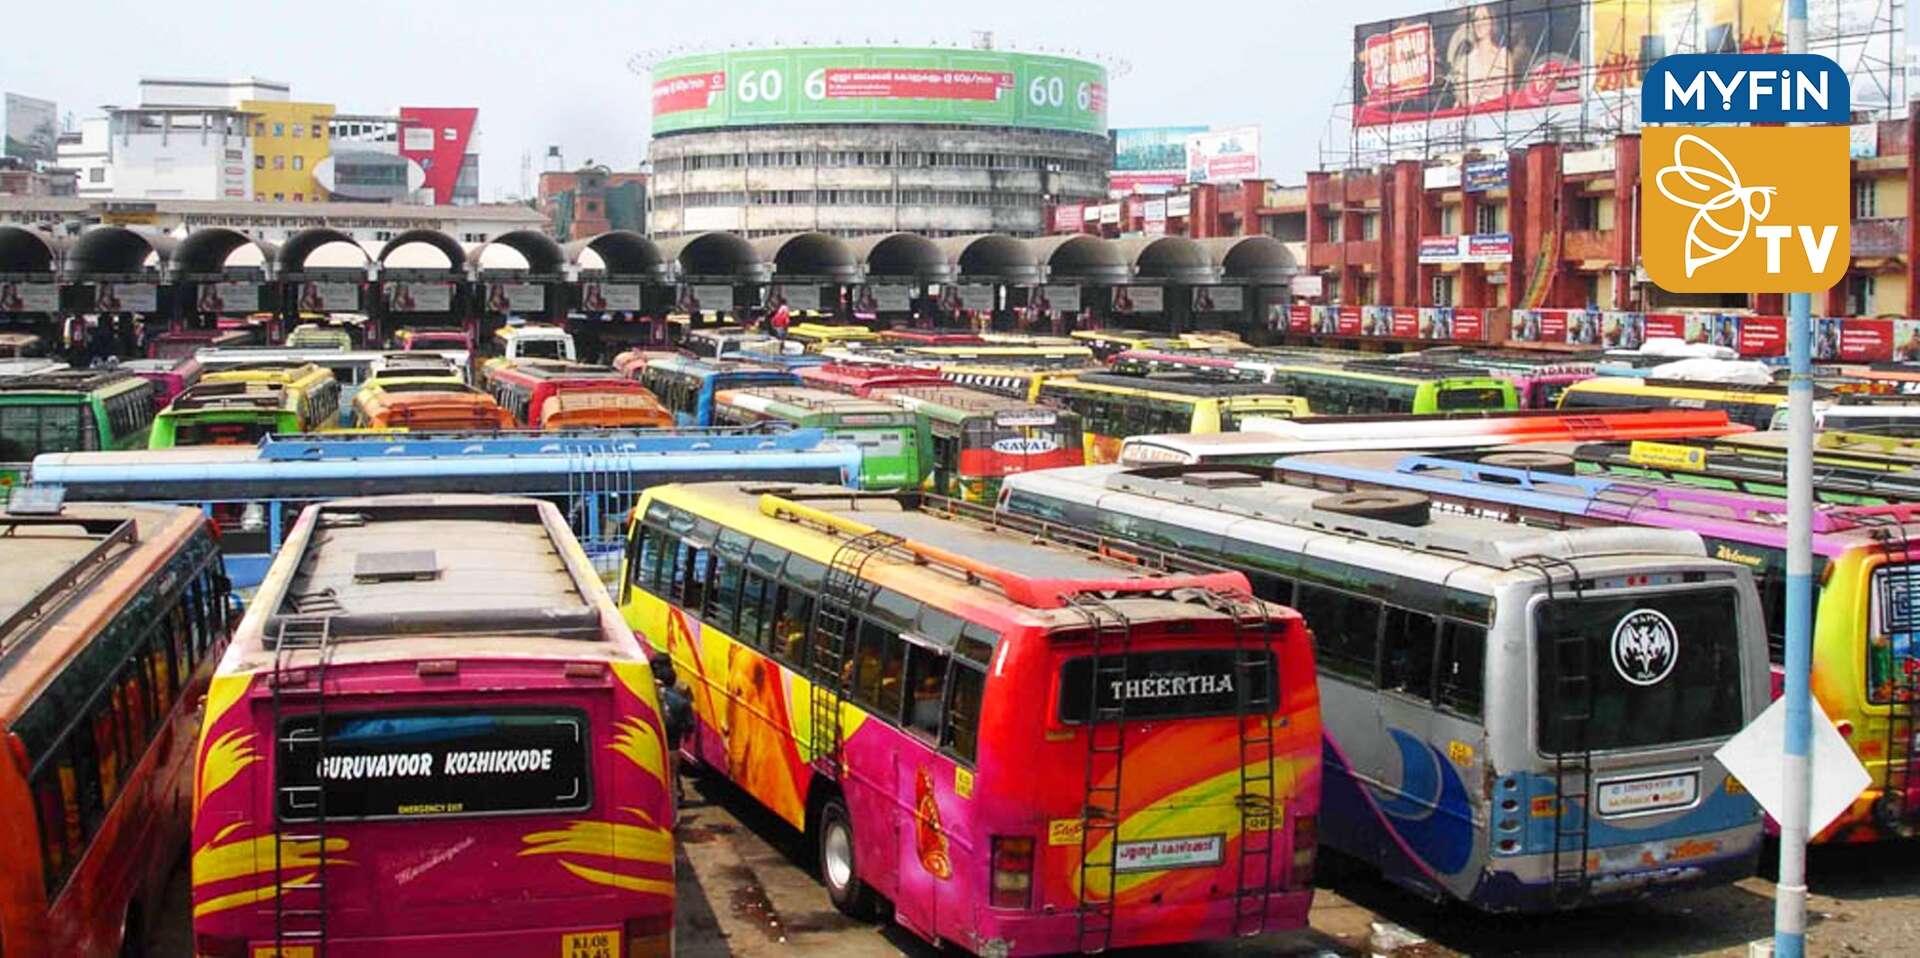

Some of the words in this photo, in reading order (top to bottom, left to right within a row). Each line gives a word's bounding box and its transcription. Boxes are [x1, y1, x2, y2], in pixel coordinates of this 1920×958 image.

[739, 69, 782, 103] 60
[1030, 76, 1063, 107] 60
[998, 441, 1052, 451] NAVAL
[1111, 674, 1234, 700] THEERTHA
[316, 753, 433, 780] GURUVAYOOR
[444, 749, 553, 776] KOZHIKKODE
[398, 804, 446, 814] EMERGENCY
